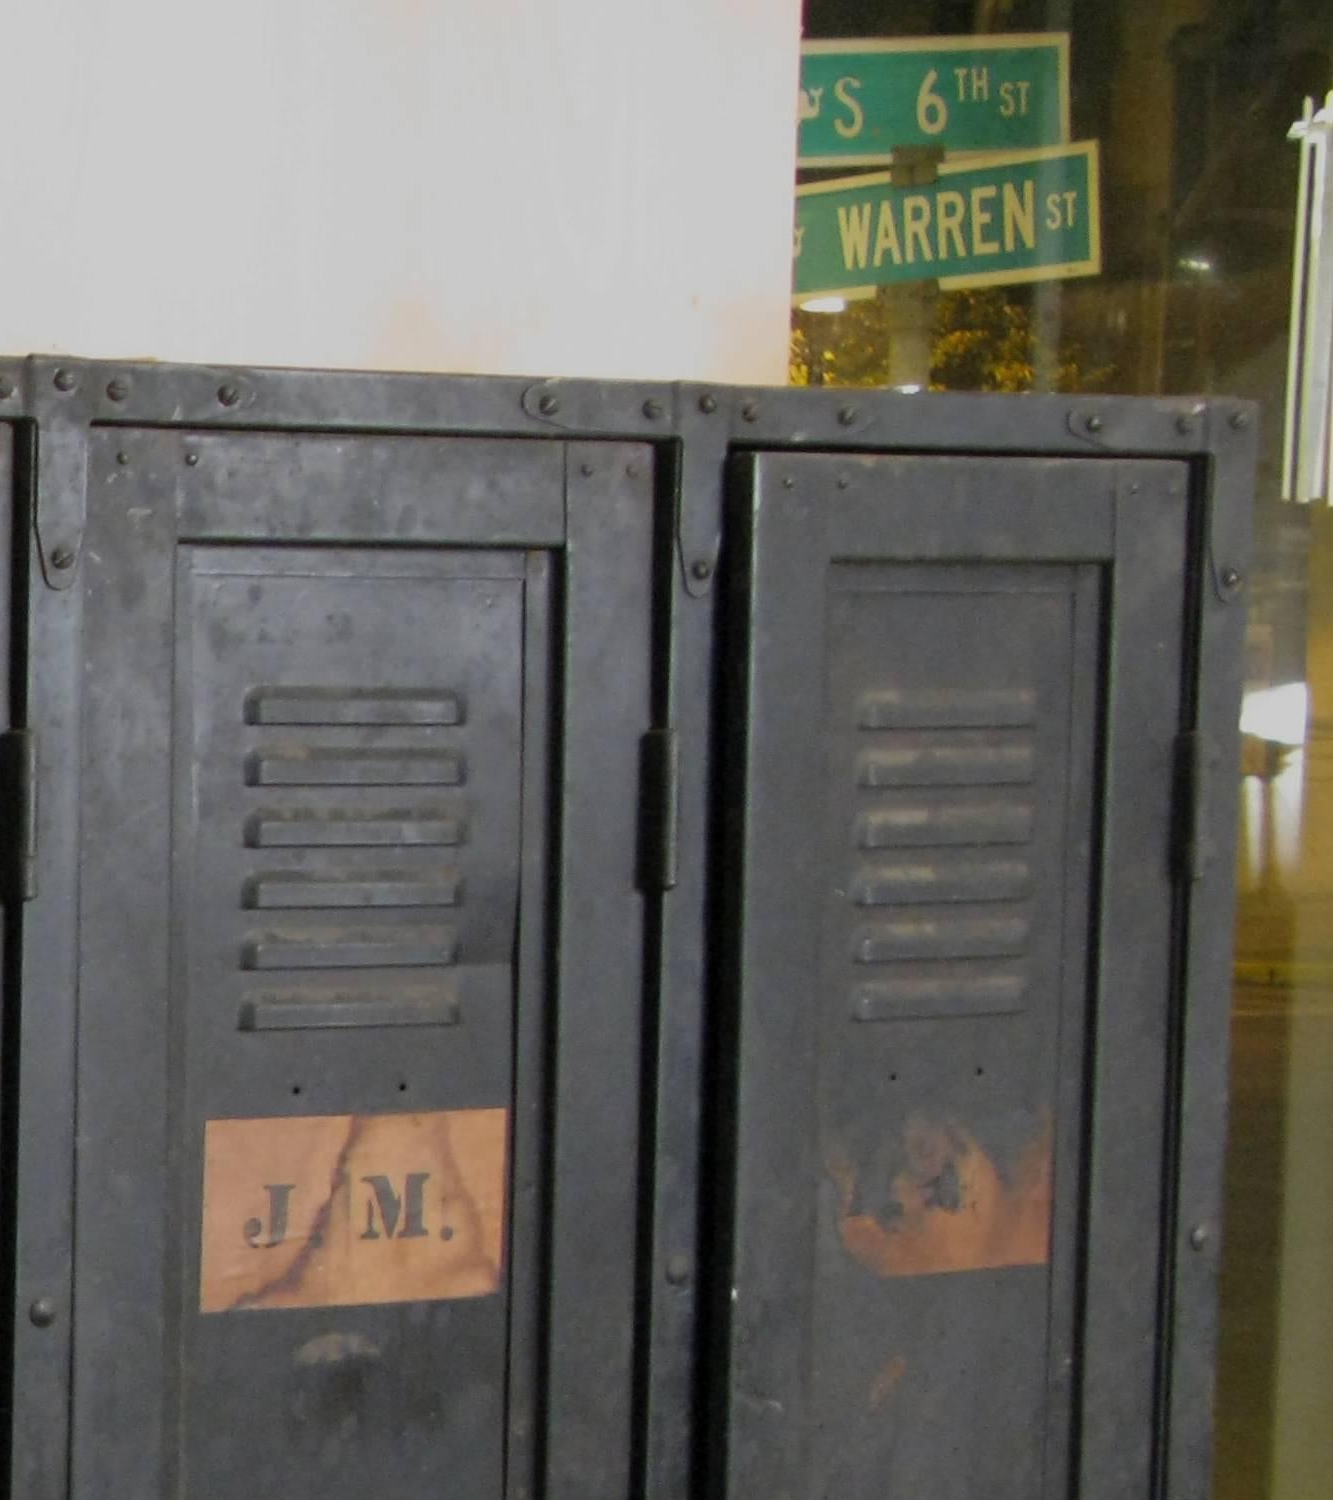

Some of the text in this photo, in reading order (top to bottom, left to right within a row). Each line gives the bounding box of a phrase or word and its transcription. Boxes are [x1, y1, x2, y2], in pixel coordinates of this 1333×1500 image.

[833, 77, 864, 138] S
[998, 80, 1030, 118] ST
[837, 179, 1077, 271] WARREN ST
